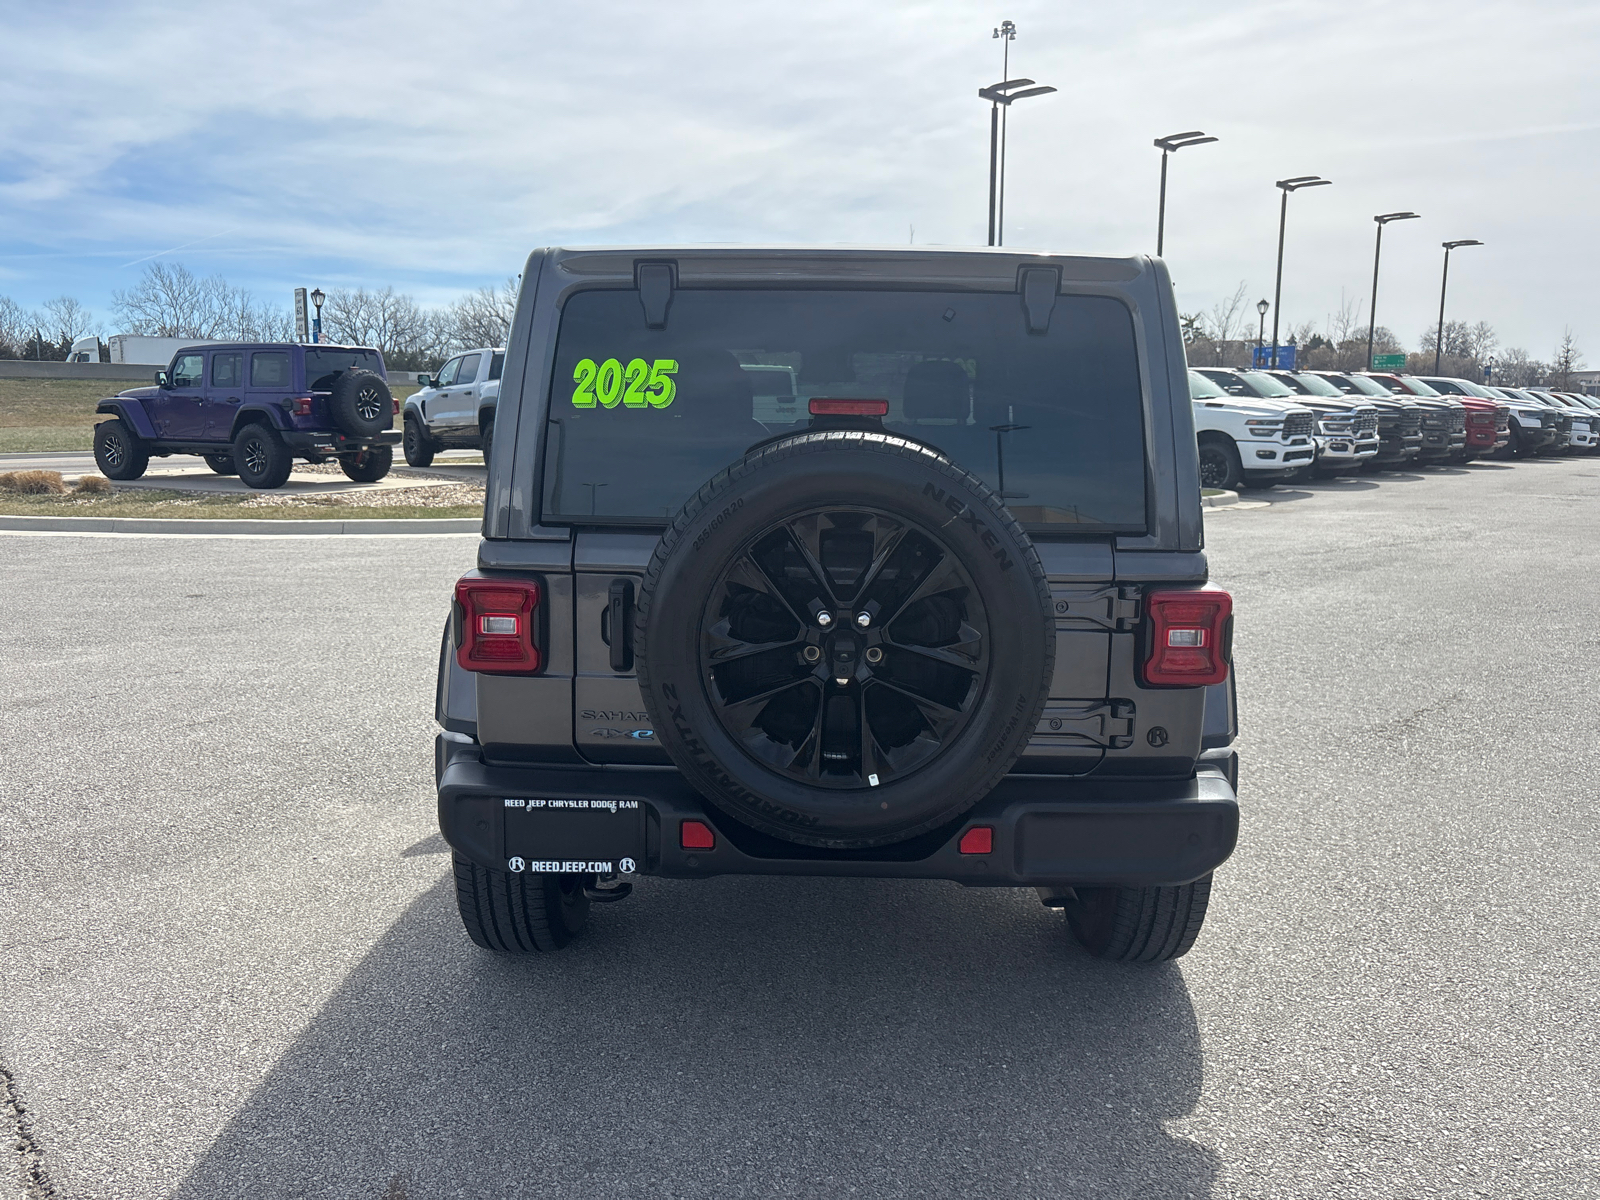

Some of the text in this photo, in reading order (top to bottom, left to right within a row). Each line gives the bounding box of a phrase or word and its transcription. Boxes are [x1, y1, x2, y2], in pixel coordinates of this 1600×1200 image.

[571, 358, 679, 409] 2025
[775, 405, 796, 415] Jeep
[692, 497, 744, 552] 255/60R20
[922, 481, 1014, 571] NEXEN
[580, 710, 650, 722] SAHAR
[986, 693, 1027, 764] All-Weather
[504, 799, 638, 809] REED JEEP CHRYSLER DODGE RAM
[702, 760, 820, 826] ROADIAN
[532, 861, 612, 873] REEDJEEP.COM
